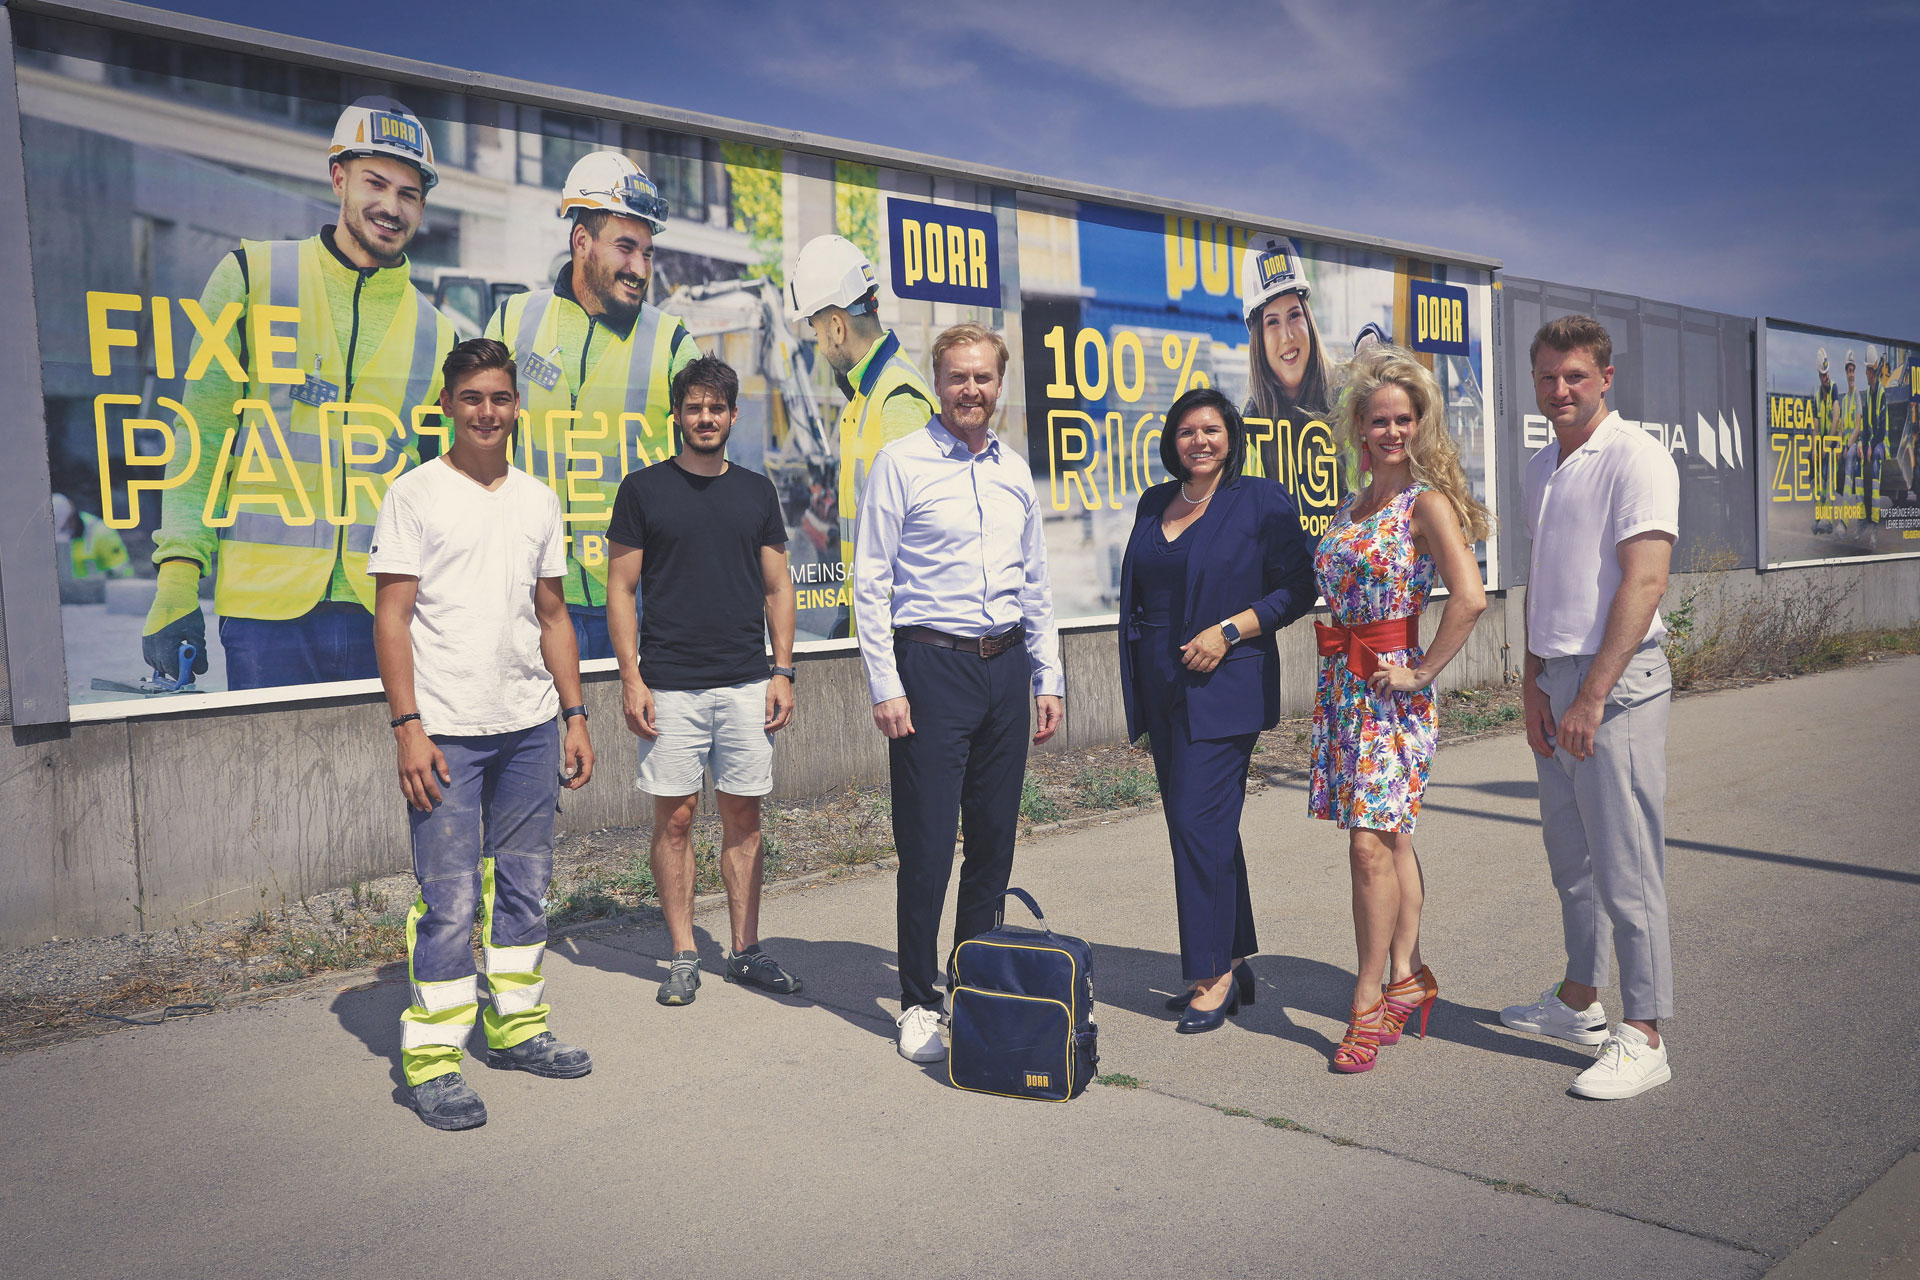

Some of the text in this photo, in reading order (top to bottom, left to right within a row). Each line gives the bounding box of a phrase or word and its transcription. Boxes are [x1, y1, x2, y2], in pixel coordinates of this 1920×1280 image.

[381, 117, 416, 144] PORR
[902, 218, 988, 289] PORR
[1263, 253, 1288, 279] PORR
[1417, 294, 1463, 343] PORR
[86, 290, 306, 385] FIXE
[1043, 325, 1211, 403] 100 %
[1771, 396, 1815, 430] MEGA
[1771, 433, 1843, 502] ZEIT
[1300, 515, 1334, 536] POR
[1833, 506, 1843, 520] BY
[1026, 1074, 1049, 1087] PORR
